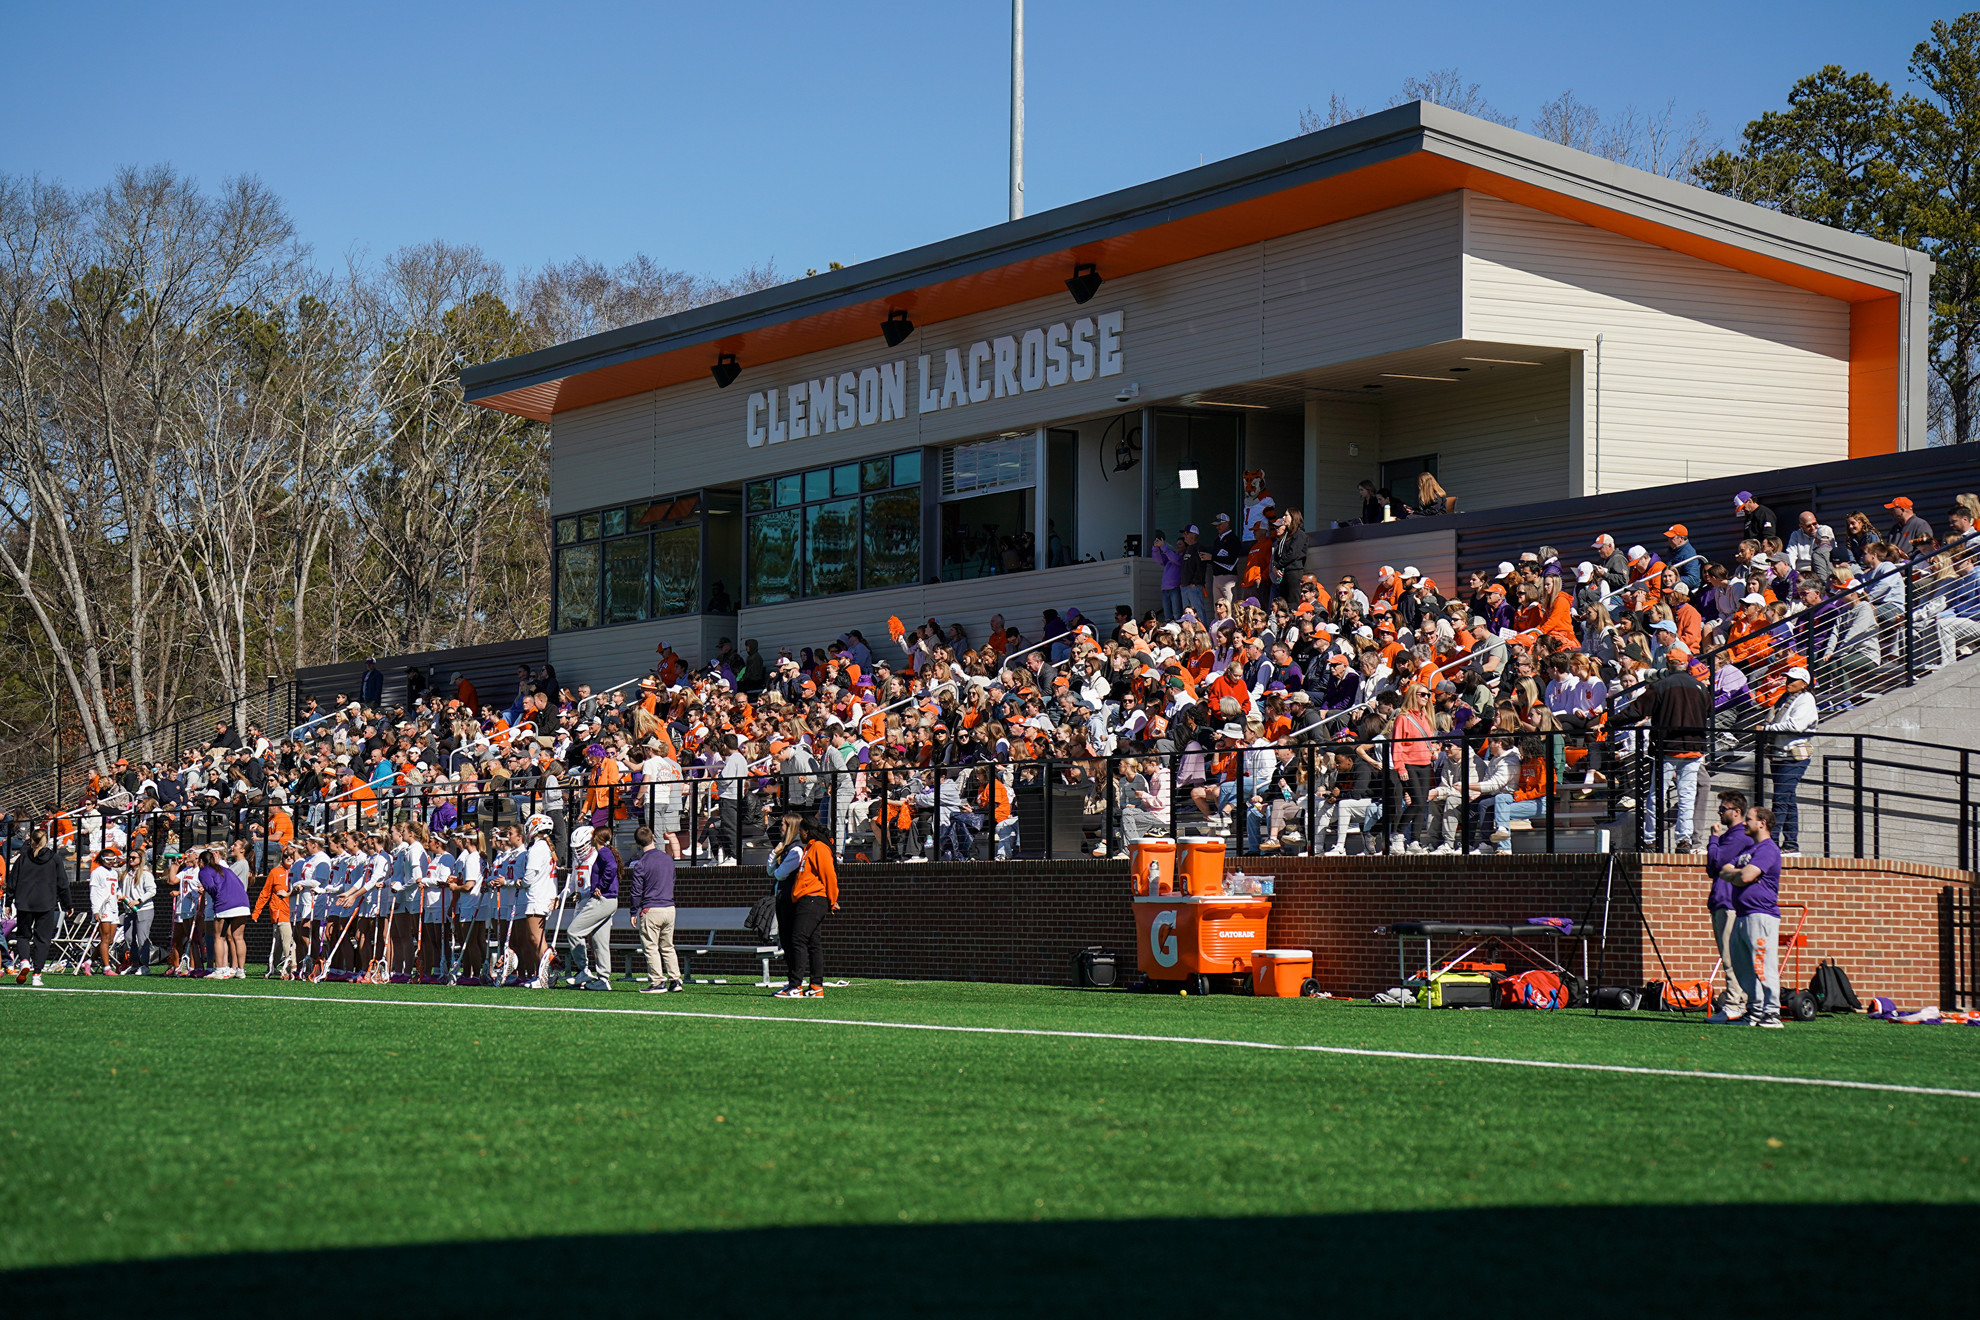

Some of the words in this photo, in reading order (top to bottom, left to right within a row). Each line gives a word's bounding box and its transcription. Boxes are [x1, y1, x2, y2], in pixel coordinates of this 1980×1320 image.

[746, 360, 906, 447] CLEMSON
[918, 310, 1123, 413] LACROSSE
[577, 871, 584, 887] 5
[1150, 910, 1178, 968] G
[1218, 930, 1255, 938] GATORADE
